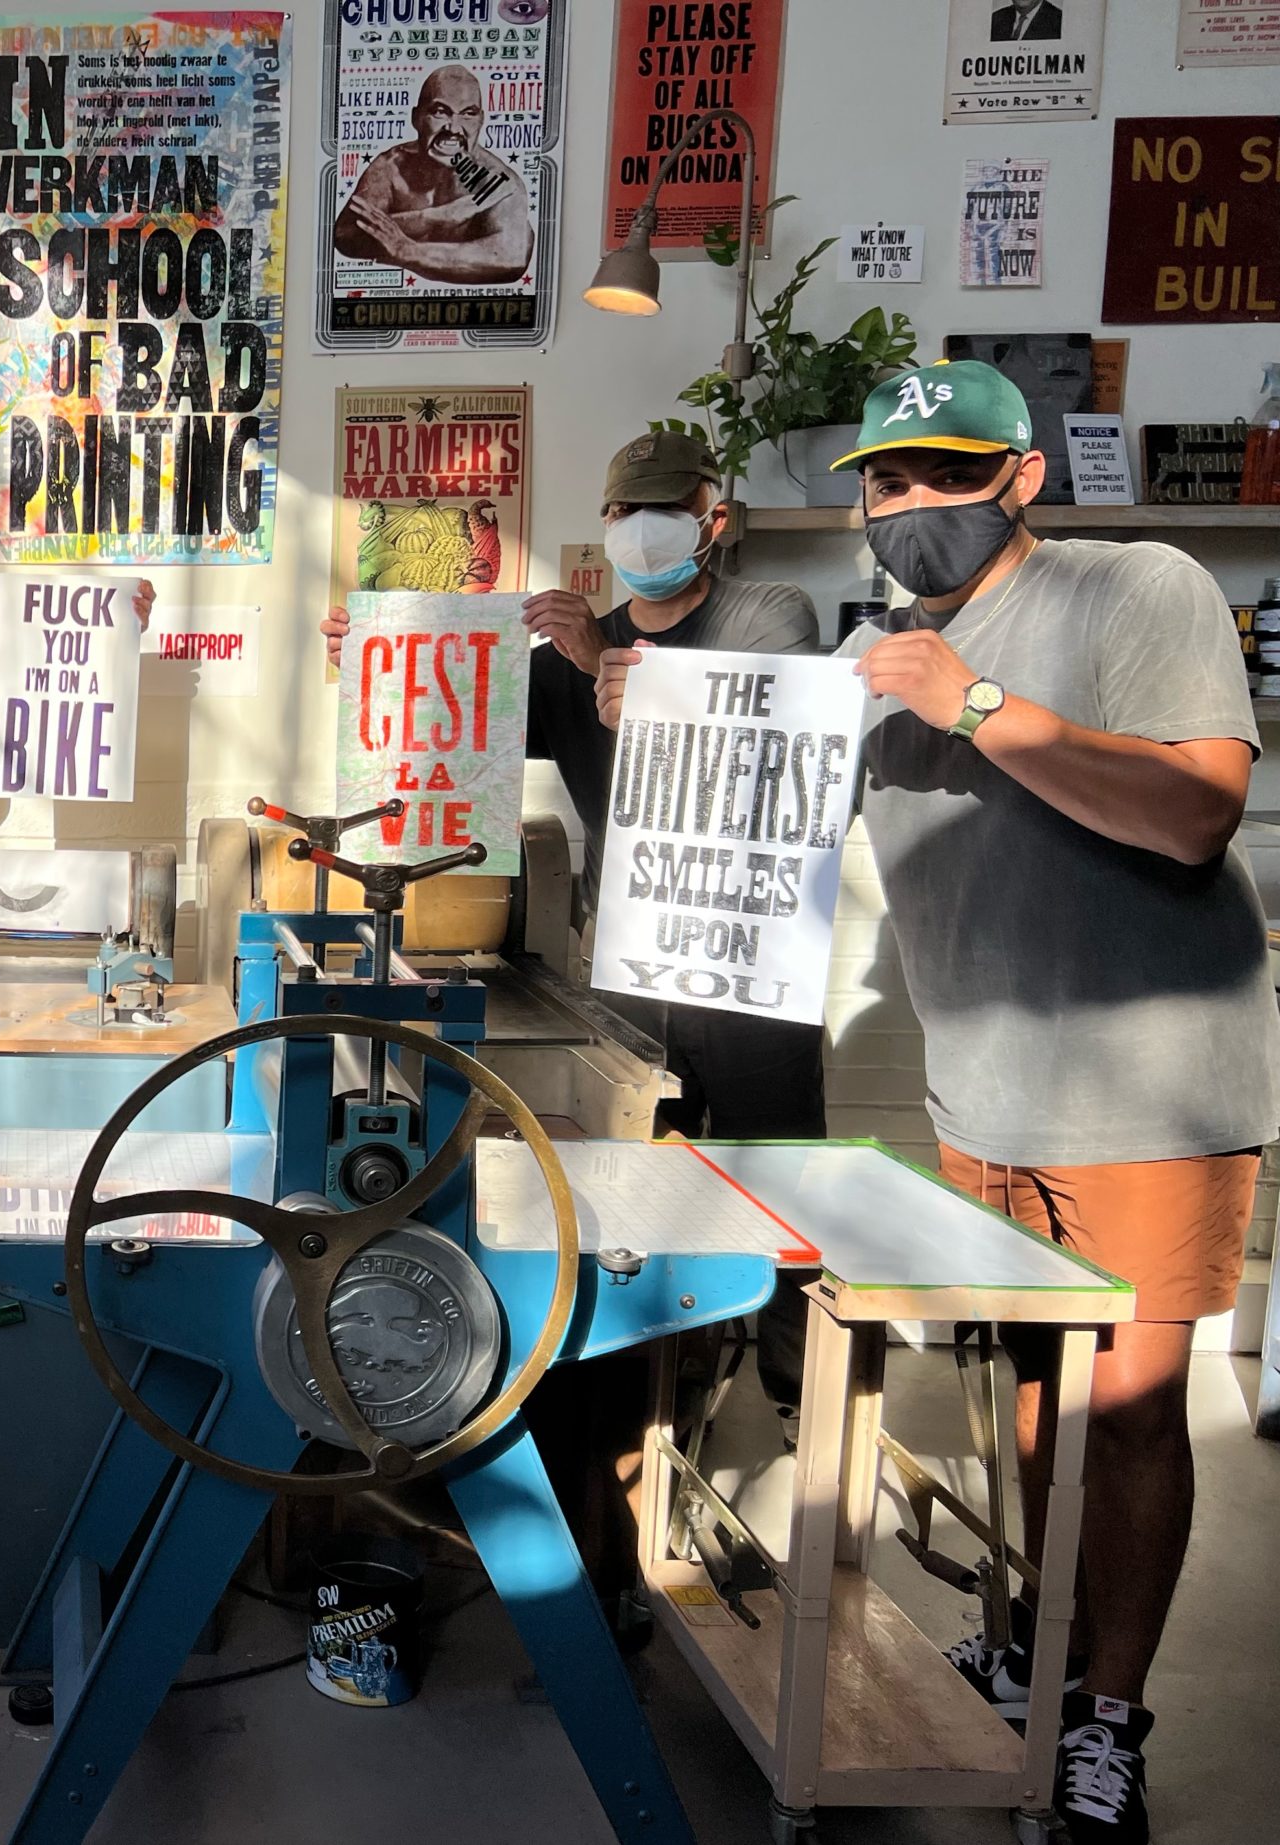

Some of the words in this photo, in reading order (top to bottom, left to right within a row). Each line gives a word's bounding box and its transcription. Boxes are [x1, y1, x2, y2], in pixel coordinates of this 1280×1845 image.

[342, 0, 492, 25] CHURCH
[647, 2, 753, 43] PLEASE
[388, 28, 540, 43] AMERICAN
[78, 55, 105, 68] Soms
[110, 55, 119, 67] is
[144, 55, 176, 68] noodig
[180, 56, 212, 67] zwaar
[348, 46, 539, 61] TYPOGRAPHY
[638, 46, 701, 77] STAY
[710, 44, 756, 75] OFF
[962, 54, 1085, 77] COUNCILMAN
[125, 76, 152, 87] soms
[156, 75, 177, 87] heel
[182, 74, 203, 86] licht
[208, 76, 235, 87] soms
[349, 77, 410, 87] CULTURALLY
[491, 72, 540, 80] OUR
[78, 96, 107, 108] wordt
[127, 97, 145, 107] ene
[176, 96, 195, 107] van
[199, 94, 215, 107] het
[340, 92, 372, 107] LIKE
[377, 91, 409, 106] HAIR
[488, 83, 542, 112] KARATE
[655, 80, 684, 110] OF
[695, 79, 734, 109] ALL
[979, 98, 1008, 107] Vote
[1013, 96, 1041, 106] Row
[168, 115, 191, 127] (met
[342, 120, 405, 140] BISCUIT
[647, 114, 737, 152] BUSES
[93, 136, 127, 147] andere
[159, 135, 196, 147] schraal
[485, 124, 541, 148] STRONG
[621, 156, 650, 185] ON
[1131, 136, 1203, 184] NO
[450, 153, 488, 195] SUCK
[471, 172, 510, 207] IT
[999, 169, 1042, 182] THE
[965, 191, 1040, 220] FUTURE
[860, 230, 875, 245] WE
[878, 230, 905, 245] KNOW
[1016, 228, 1036, 241] IS
[1174, 201, 1228, 247] IN
[851, 247, 877, 262] WHAT
[881, 246, 912, 261] YOU'RE
[999, 249, 1035, 277] NOW
[857, 264, 870, 279] UP
[873, 263, 884, 279] TO
[354, 303, 440, 326] CHURCH
[445, 303, 470, 325] OF
[476, 301, 531, 324] TYPE
[51, 331, 107, 399] OF
[116, 323, 268, 413] BAD
[346, 398, 406, 414] SOUTHERN
[453, 396, 521, 412] CALIFORNIA
[883, 376, 953, 428] A's
[1078, 428, 1112, 436] NOTICE
[344, 423, 520, 476] FARMER'S
[1081, 453, 1117, 461] SANITIZE
[9, 415, 263, 535] PRINTING
[343, 475, 519, 499] MARKET
[570, 569, 603, 593] ART
[24, 584, 117, 627] FUCK
[43, 630, 91, 666] YOU
[160, 634, 243, 660] !AGITPROP!
[25, 668, 49, 692] I'M
[59, 670, 80, 694] ON
[88, 672, 99, 695] A
[359, 631, 500, 752] C'EST
[705, 671, 776, 718] THE
[2, 697, 115, 799] BIKE
[395, 762, 455, 791] LA
[613, 718, 848, 850] UNIVERSE
[377, 801, 472, 847] VIE
[627, 840, 803, 918] SMILES
[656, 912, 760, 967] UPON
[619, 957, 791, 1009] YOU
[360, 1257, 434, 1288] GRIFFIN
[312, 1602, 395, 1643] PREMIUM
[1104, 1700, 1121, 1708] NIKE
